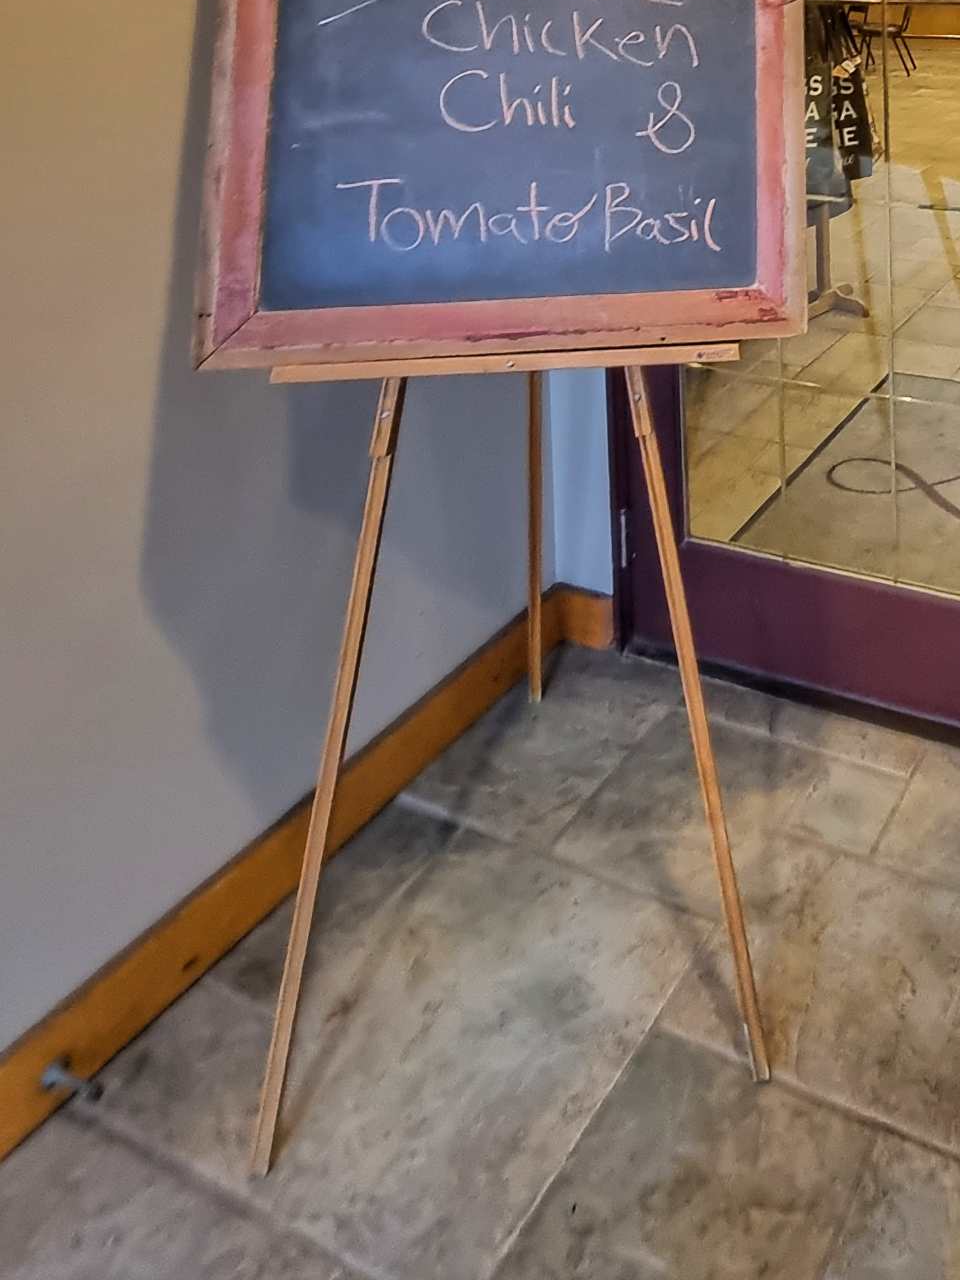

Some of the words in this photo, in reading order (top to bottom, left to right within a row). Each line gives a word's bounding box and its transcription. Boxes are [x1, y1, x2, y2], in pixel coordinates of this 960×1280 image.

[421, 0, 700, 69] Chicken
[439, 68, 577, 132] Chili
[634, 80, 696, 154] &
[336, 177, 598, 251] Tomato
[604, 181, 722, 252] Basil
